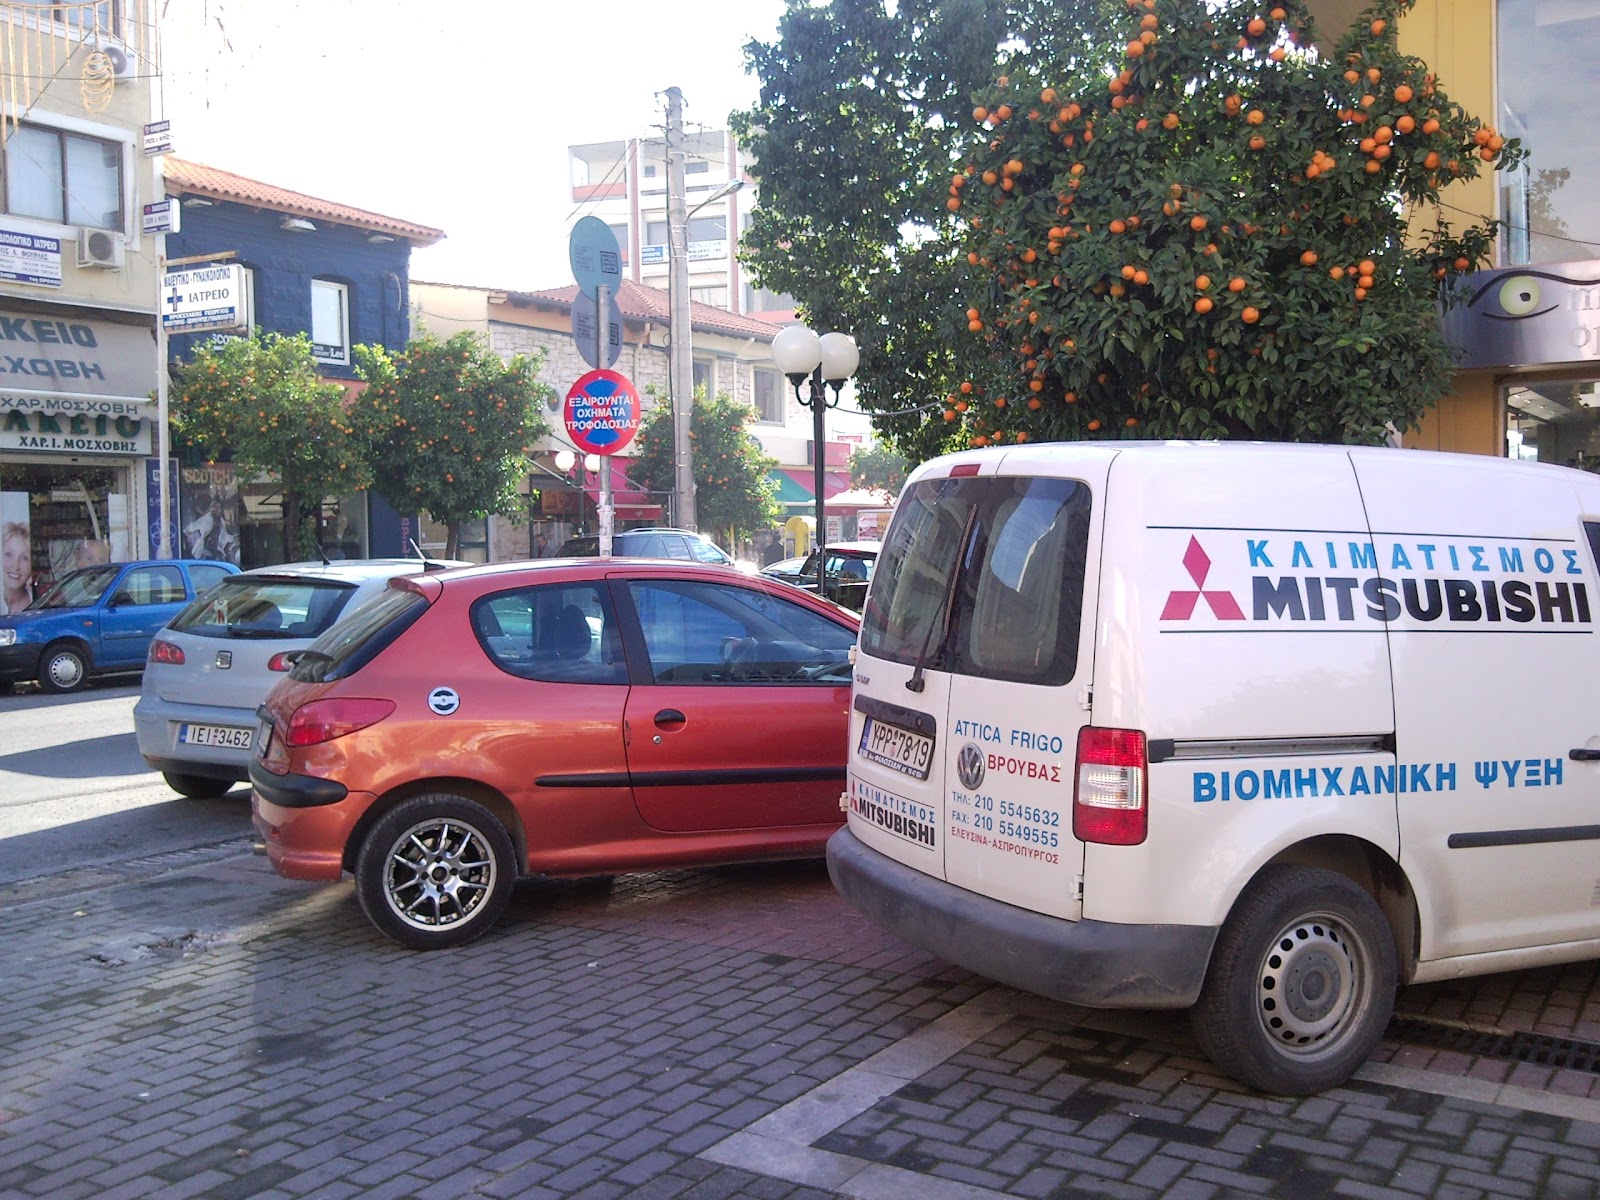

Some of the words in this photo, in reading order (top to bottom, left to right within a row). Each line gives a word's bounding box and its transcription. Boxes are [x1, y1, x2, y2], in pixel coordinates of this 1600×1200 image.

[189, 288, 230, 303] ΙΑΤΡΕΙΟ
[569, 395, 634, 407] ΕΞΑΙΡΟΥΝΤΑΙ
[576, 407, 626, 418] ΟΧΗΜΑΤΑ
[566, 419, 638, 430] ΤΡΟΦΟΔΟΣΙΑΣ
[19, 436, 49, 448] ΧΑΡ.
[63, 439, 137, 452] ΜΟΣΧΟΒΗΣ
[1247, 540, 1583, 575] ΚΛΙΜΑΤΙΣΜΟΣ
[1252, 576, 1592, 623] MITSUBISHI
[955, 719, 1001, 743] ATTICA
[1011, 730, 1062, 754] FRIGO
[988, 754, 1061, 783] ΒΡΟΥΒΑΣ
[1193, 763, 1456, 802] ΒΙΟΜΗΧΑΝΙΚΗ
[1475, 758, 1563, 789] ΨΥΞΗ
[859, 783, 935, 824] ΚΛΙΜΑΤΙΣΜΟΣ
[974, 794, 993, 811] 210
[1000, 800, 1059, 827] 5545632
[858, 796, 935, 847] MITSUBISHI
[974, 813, 993, 831] 210
[999, 820, 1059, 847] 5549555
[951, 826, 1059, 865] ΕΛΕΥΣΙΝΑ-ΑΣΠΡΟΠΥΡΓΟΣ
